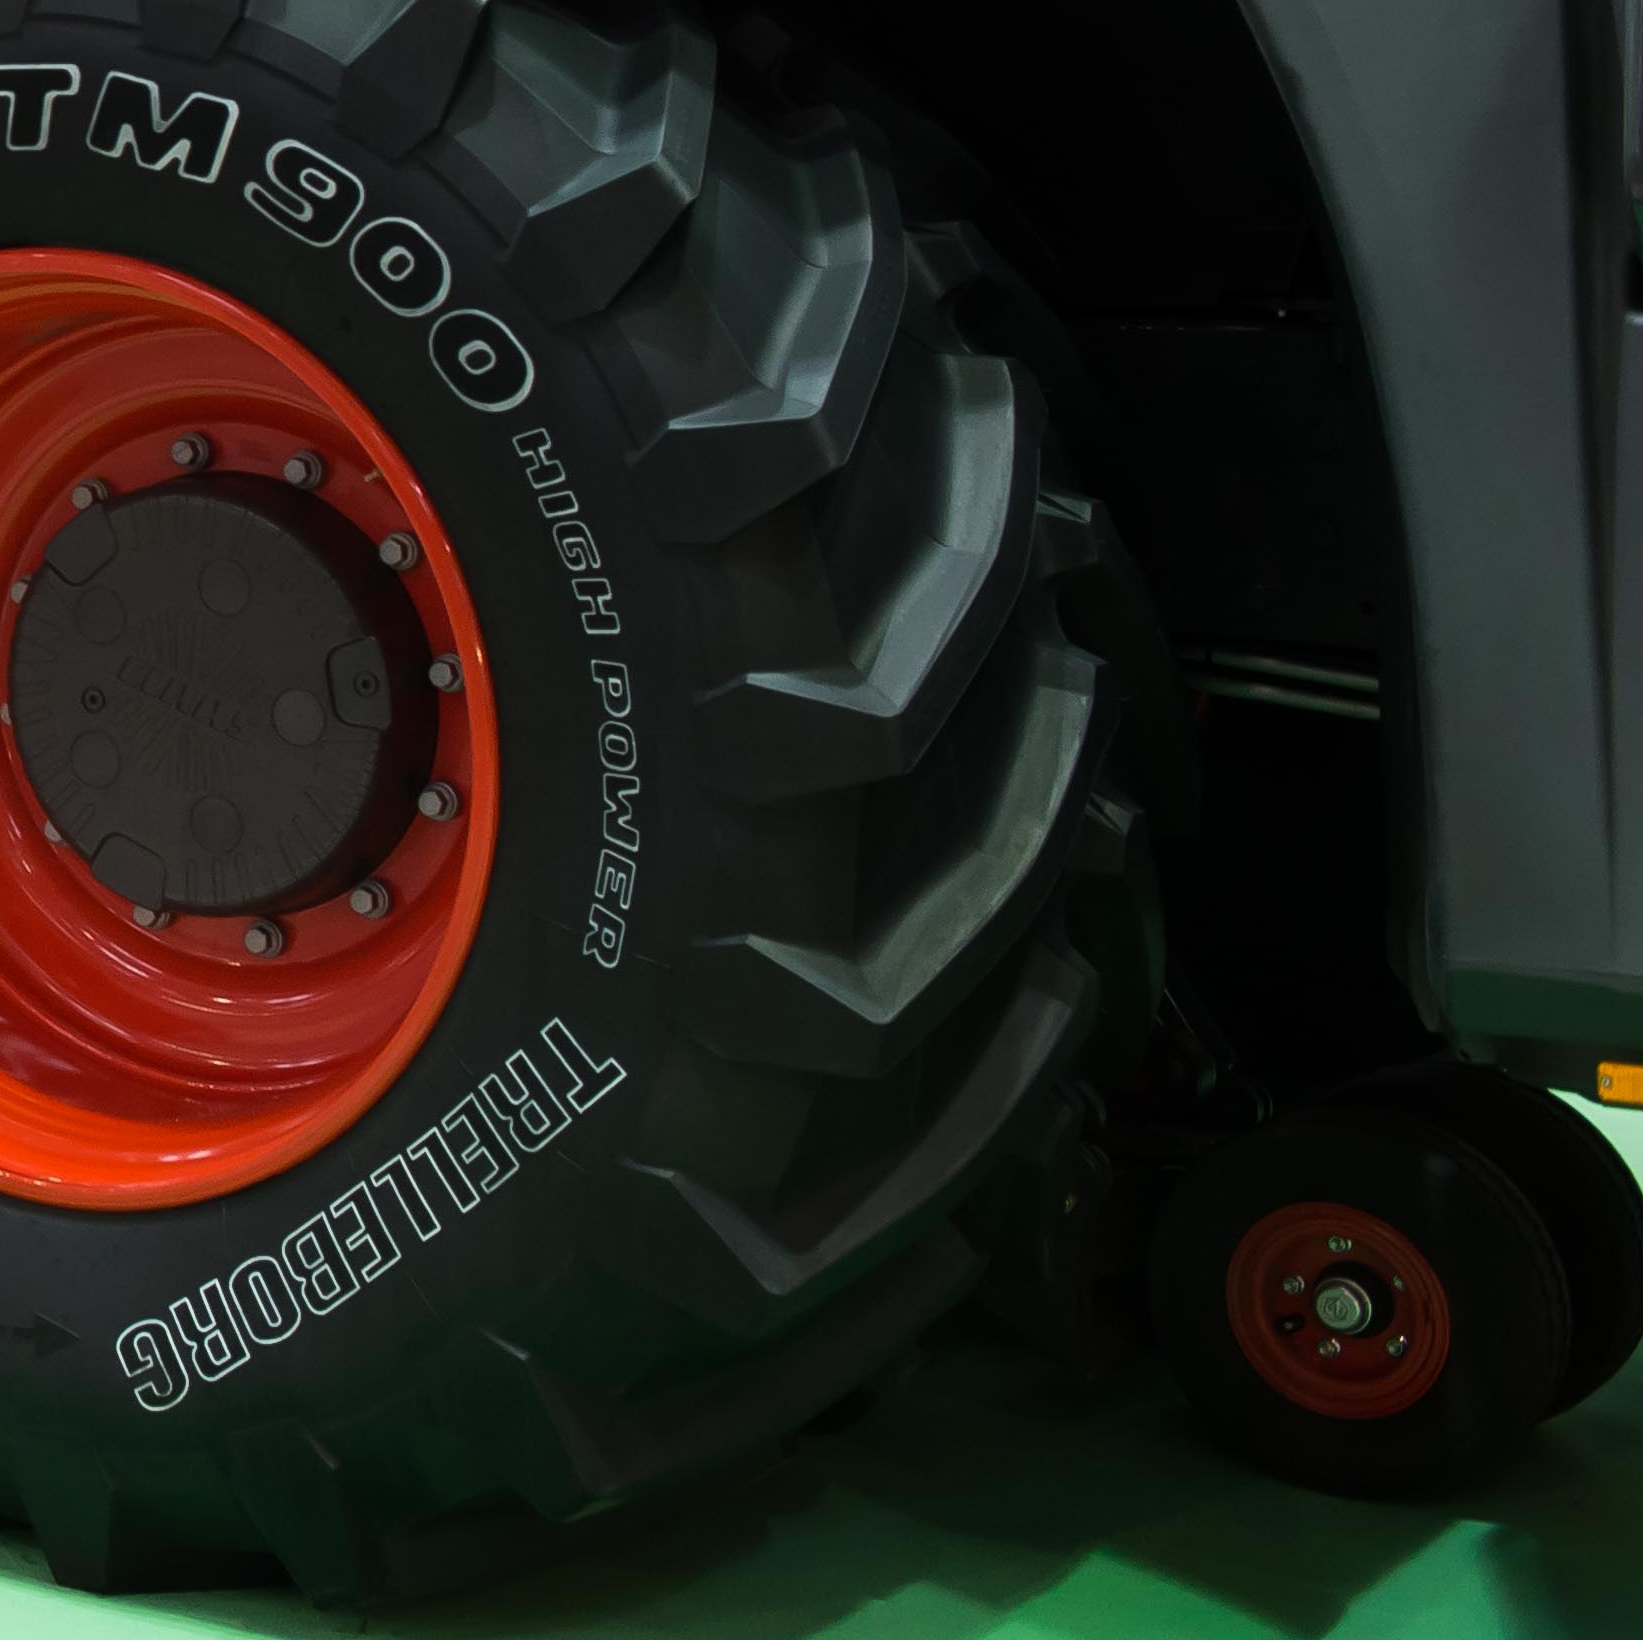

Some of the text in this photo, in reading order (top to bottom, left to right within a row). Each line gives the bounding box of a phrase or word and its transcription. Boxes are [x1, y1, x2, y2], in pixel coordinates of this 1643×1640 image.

[513, 427, 640, 969] HIGH POWER
[116, 1017, 627, 1411] TRELLEBORG
